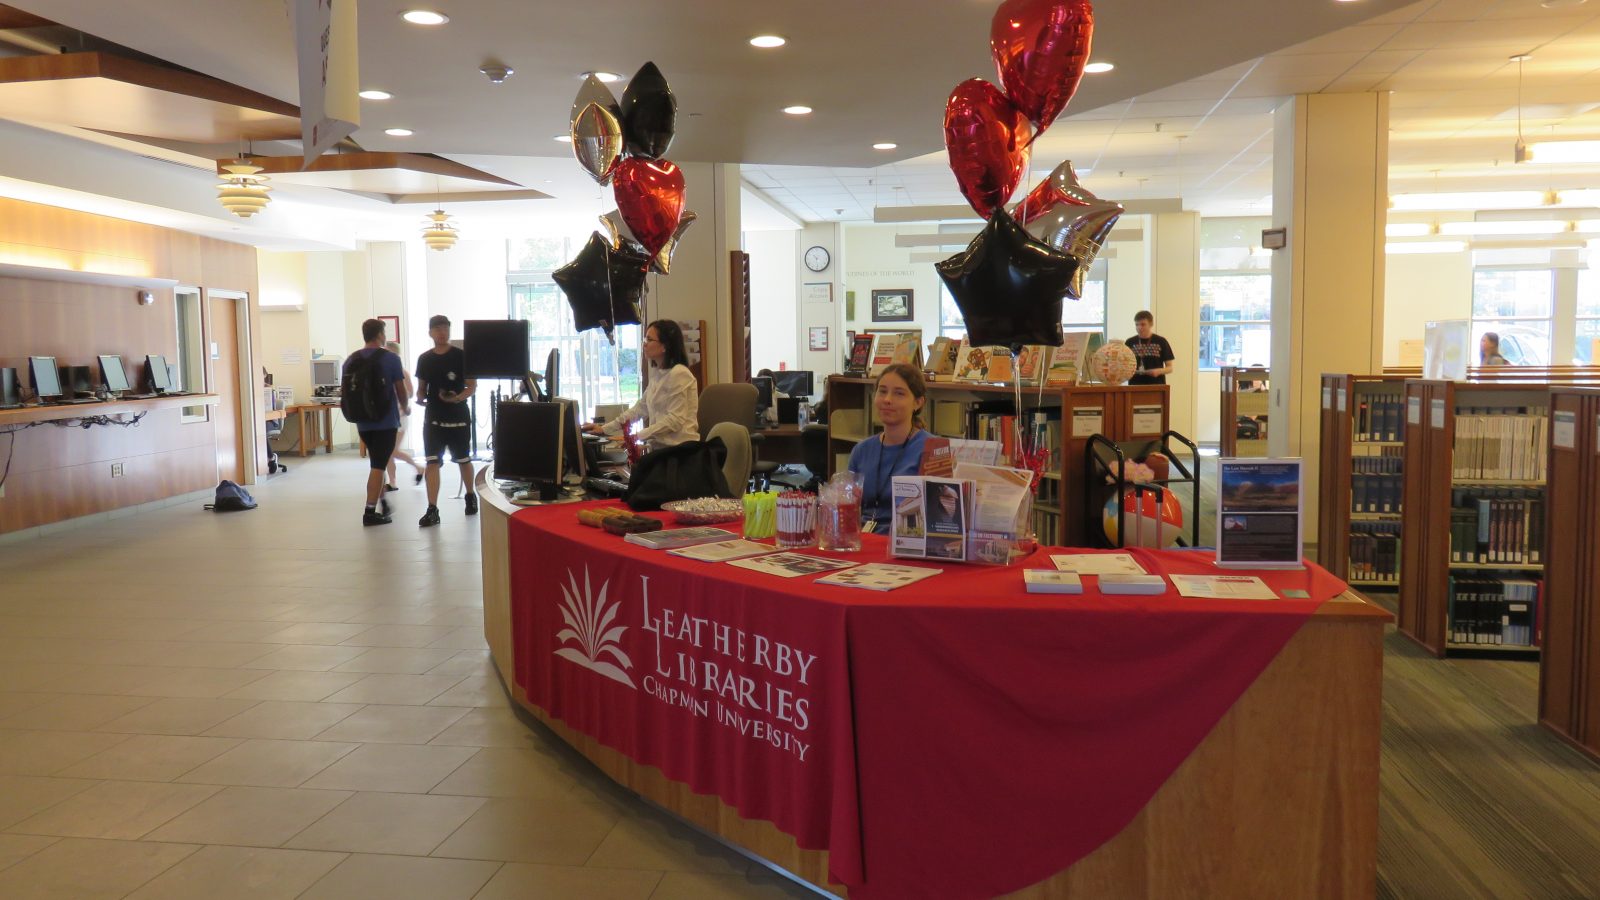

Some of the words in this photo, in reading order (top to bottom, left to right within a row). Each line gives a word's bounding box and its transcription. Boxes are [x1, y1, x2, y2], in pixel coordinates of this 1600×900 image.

[640, 575, 818, 685] LEATHERBY
[652, 617, 810, 731] LIBRARIES
[716, 700, 810, 762] UNVERSITY
